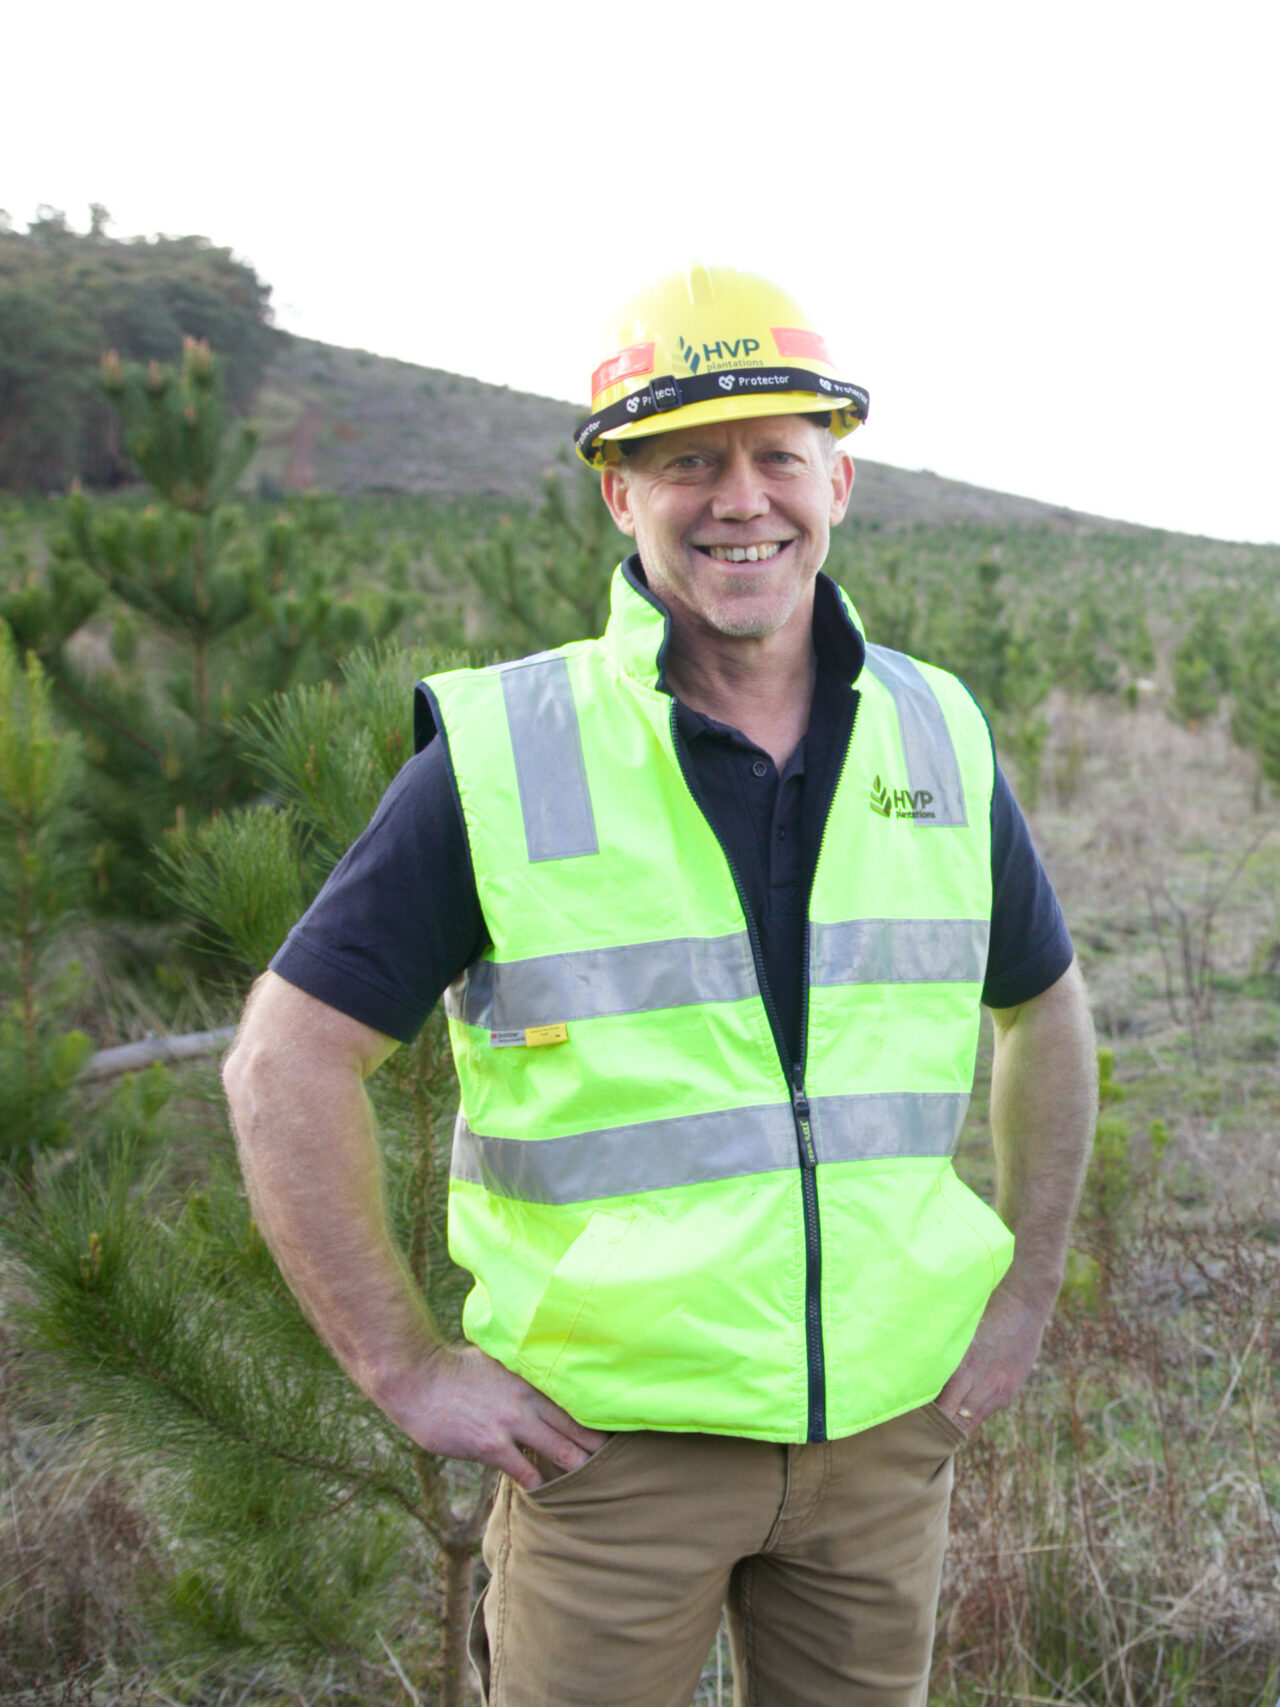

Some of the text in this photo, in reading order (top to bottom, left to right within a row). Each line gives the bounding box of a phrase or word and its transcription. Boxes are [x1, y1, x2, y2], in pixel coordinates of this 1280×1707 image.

[702, 338, 760, 361] HVP
[706, 357, 764, 372] plantations
[738, 375, 790, 386] Protector
[894, 789, 933, 809] HVP
